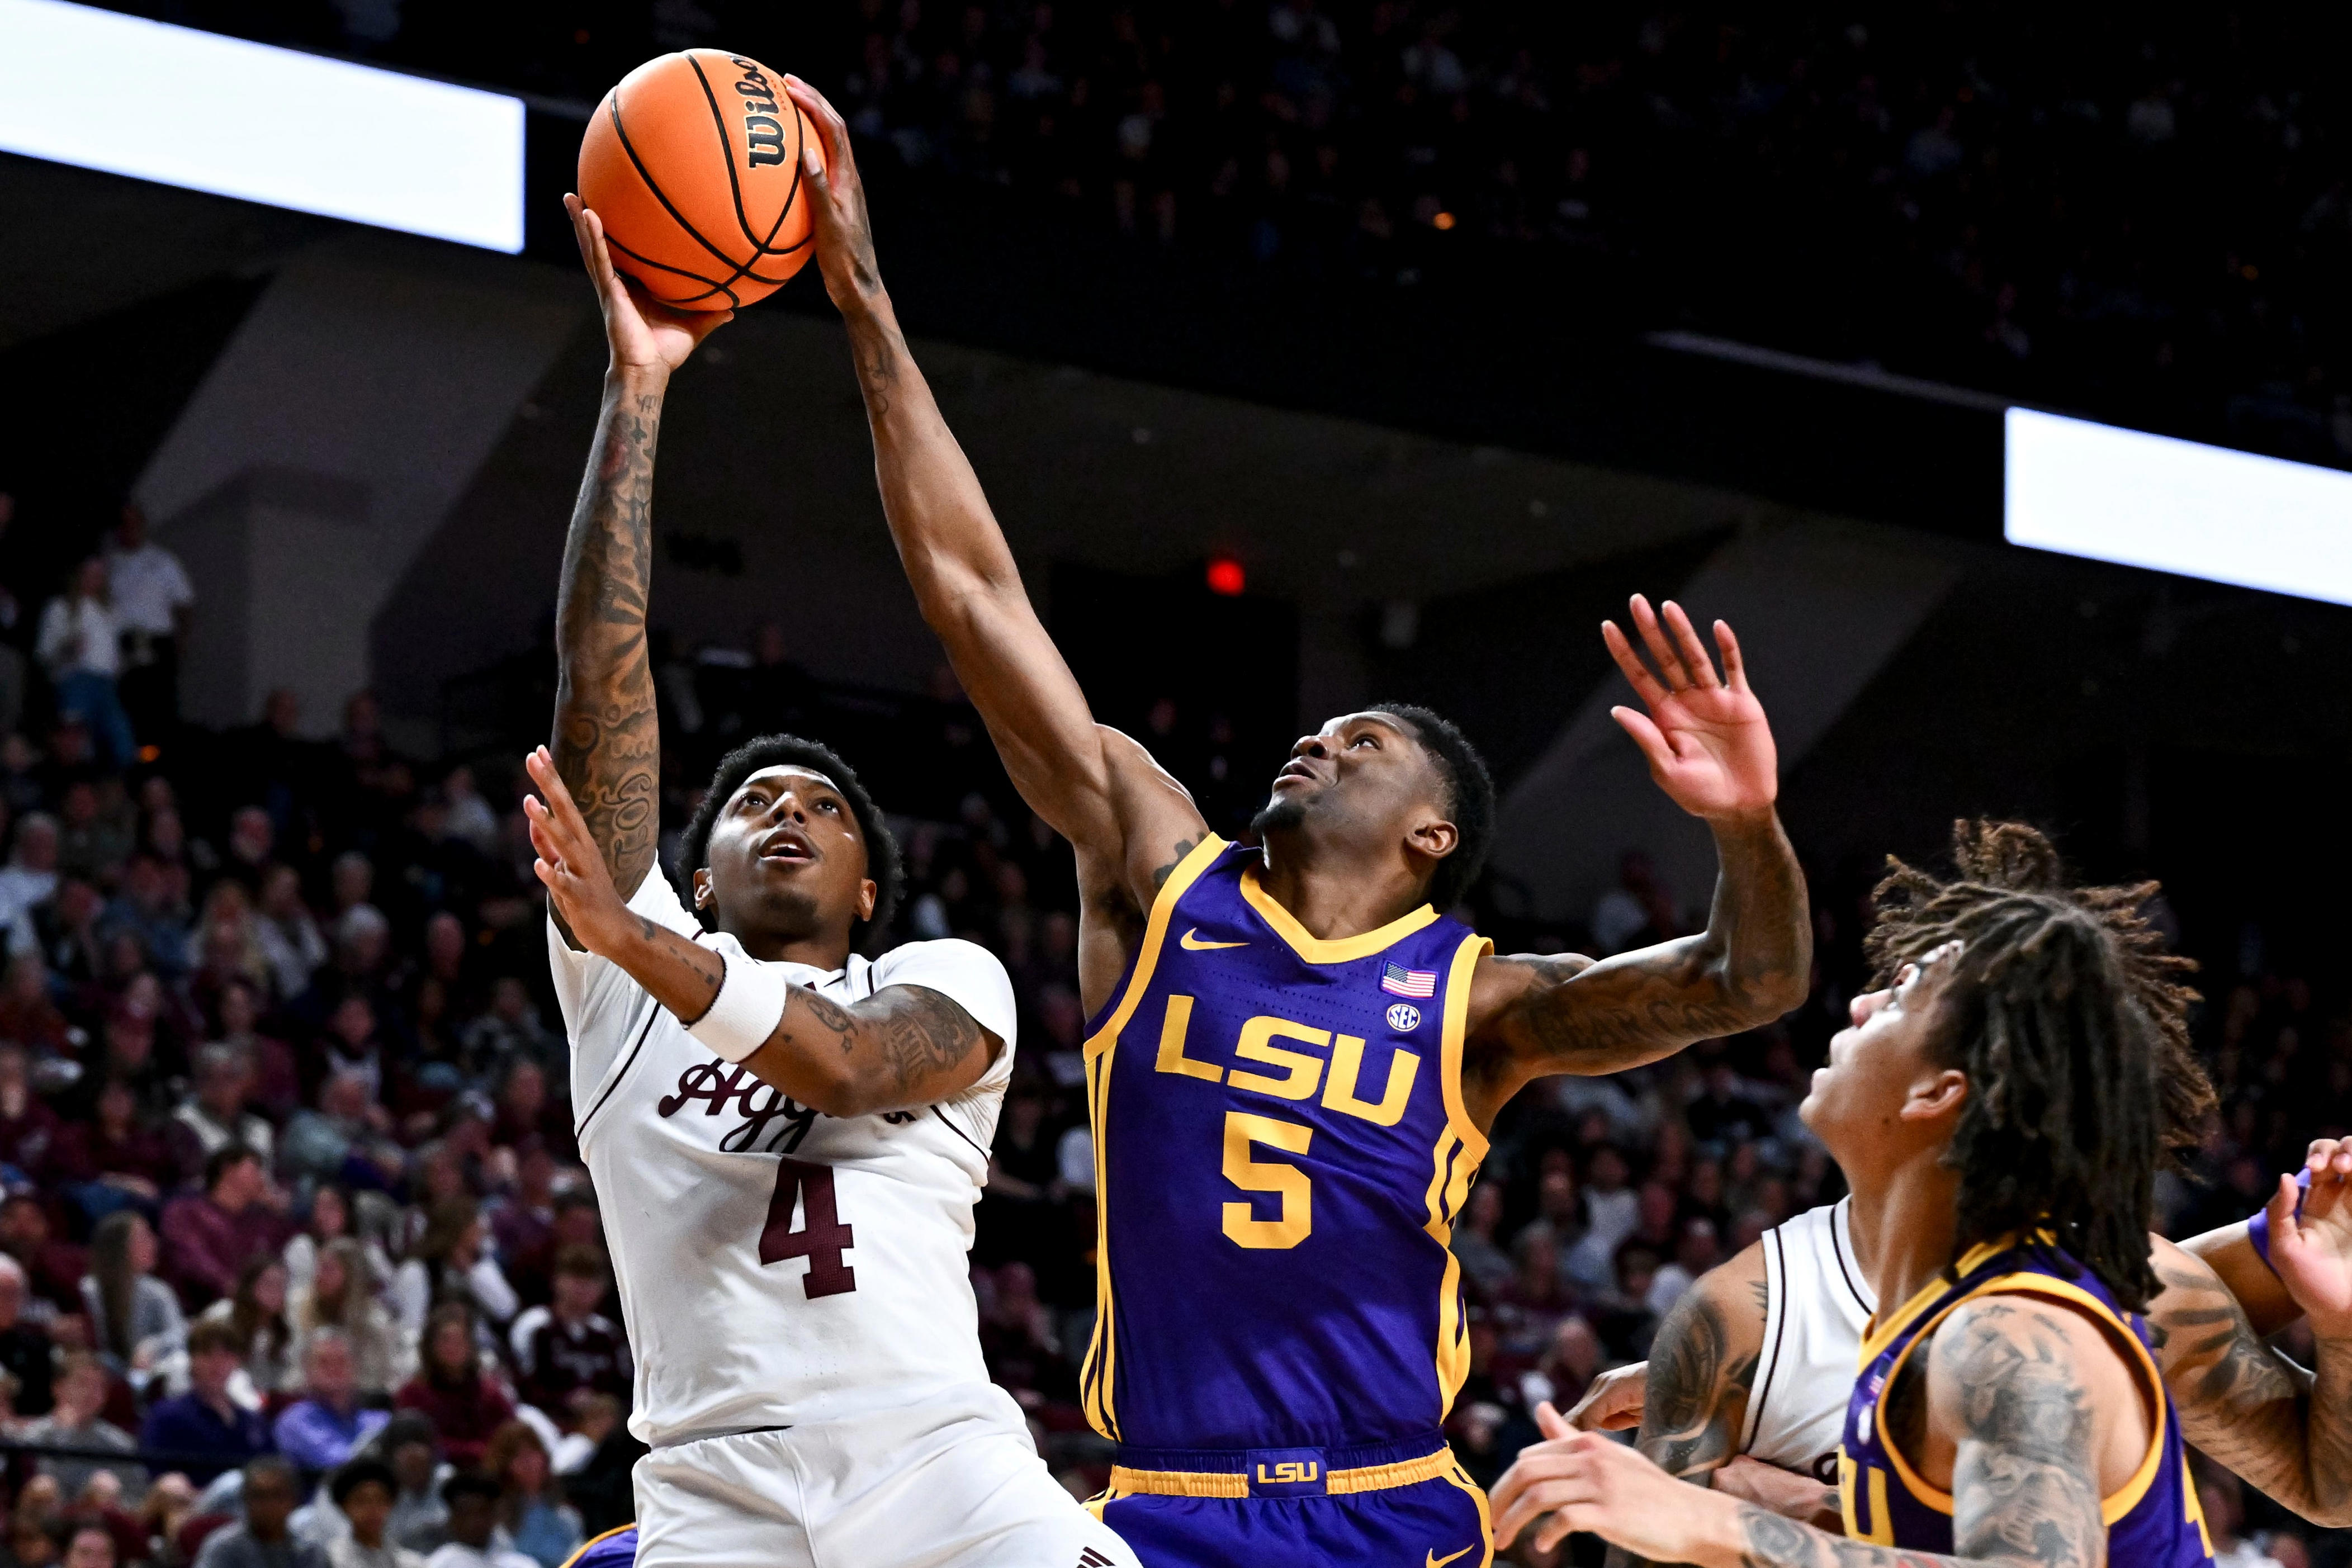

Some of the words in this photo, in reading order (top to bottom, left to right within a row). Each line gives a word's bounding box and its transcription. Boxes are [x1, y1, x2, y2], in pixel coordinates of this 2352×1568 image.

[730, 55, 786, 169] Wilso
[1154, 994, 1421, 1127] LSU
[1389, 1005, 1418, 1029] SEC
[758, 1158, 857, 1300] 4
[1222, 1111, 1313, 1249] 5
[1257, 1461, 1318, 1484] LSU
